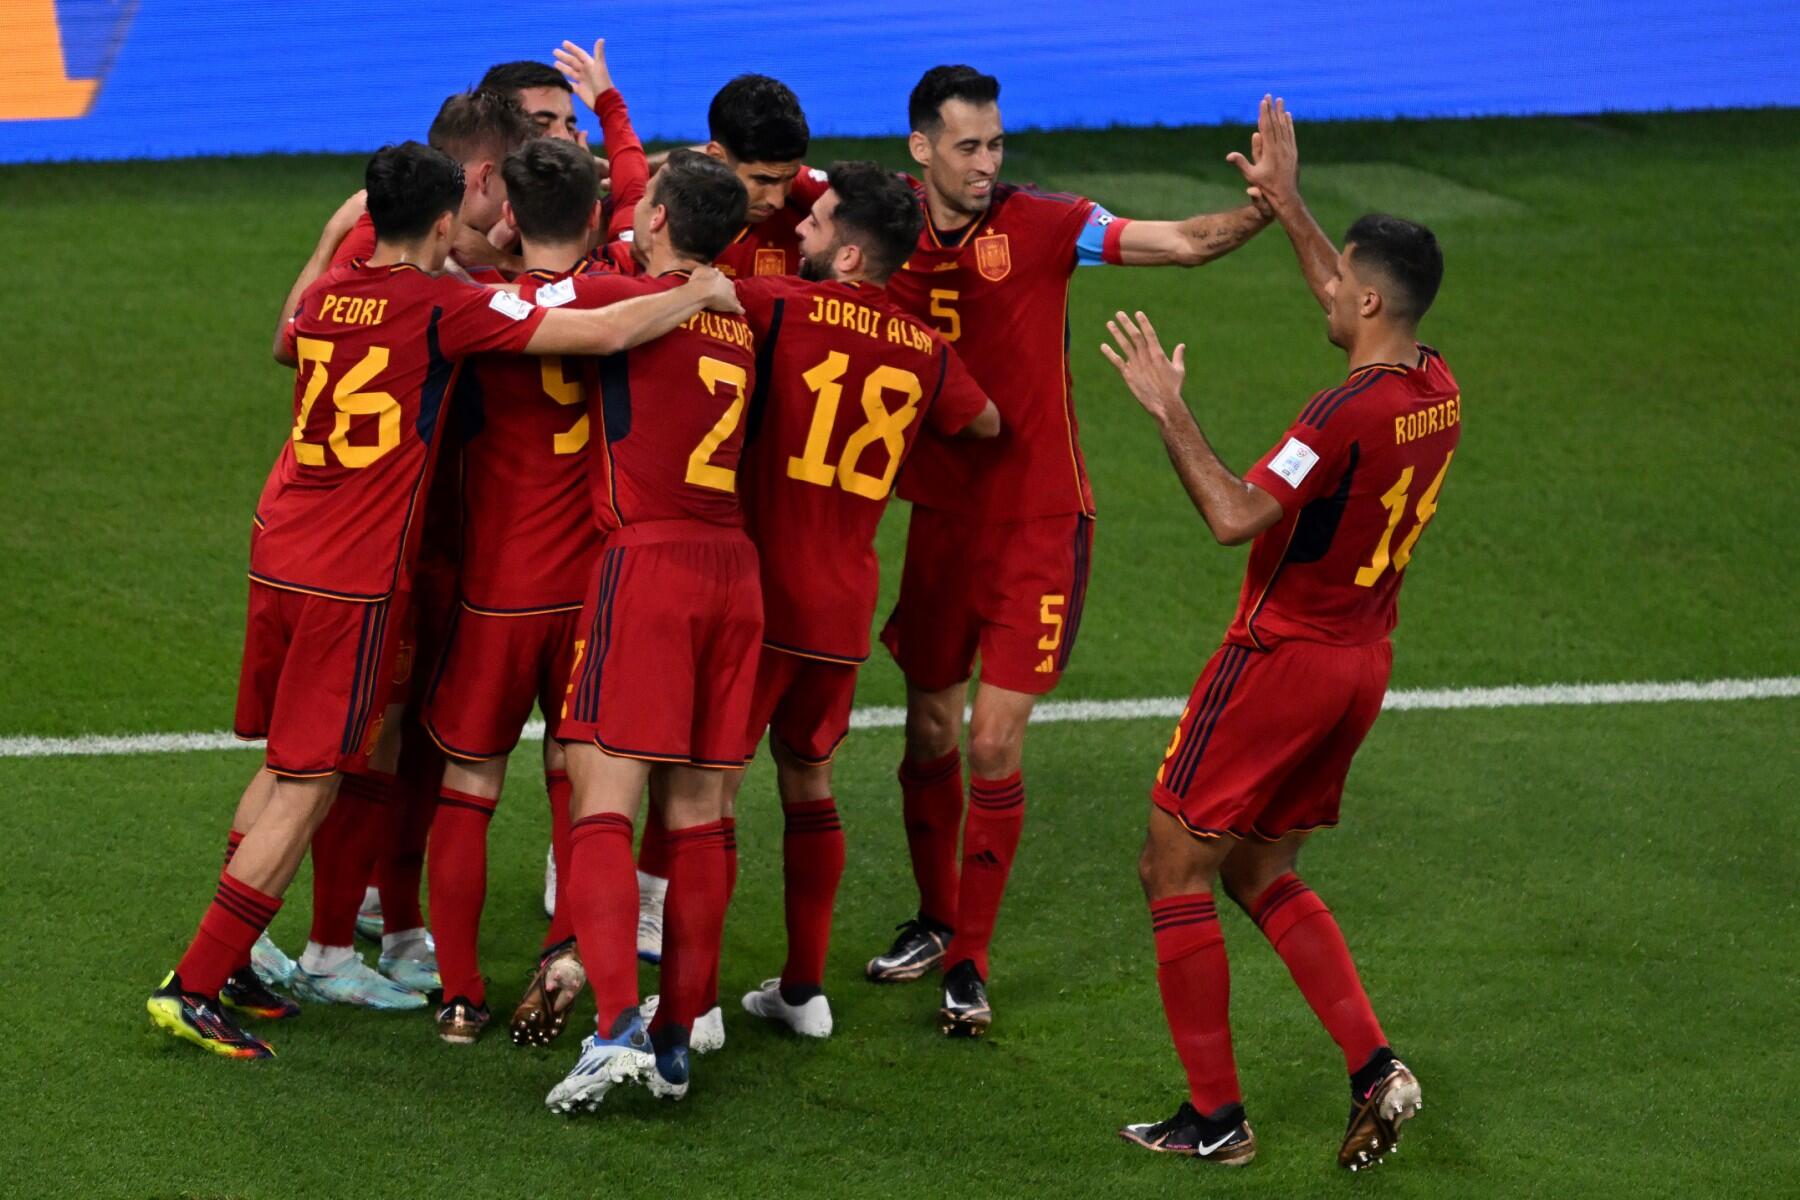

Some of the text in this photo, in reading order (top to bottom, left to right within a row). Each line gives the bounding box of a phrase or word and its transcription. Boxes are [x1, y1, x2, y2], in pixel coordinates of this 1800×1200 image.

[318, 294, 388, 325] PEDRI
[809, 296, 933, 355] JORDI ALBA
[930, 289, 961, 342] 5
[292, 337, 401, 468] 26
[685, 356, 747, 493] 2
[787, 351, 923, 501] 18
[1395, 394, 1460, 445] RODRIG
[1038, 595, 1064, 650] 5
